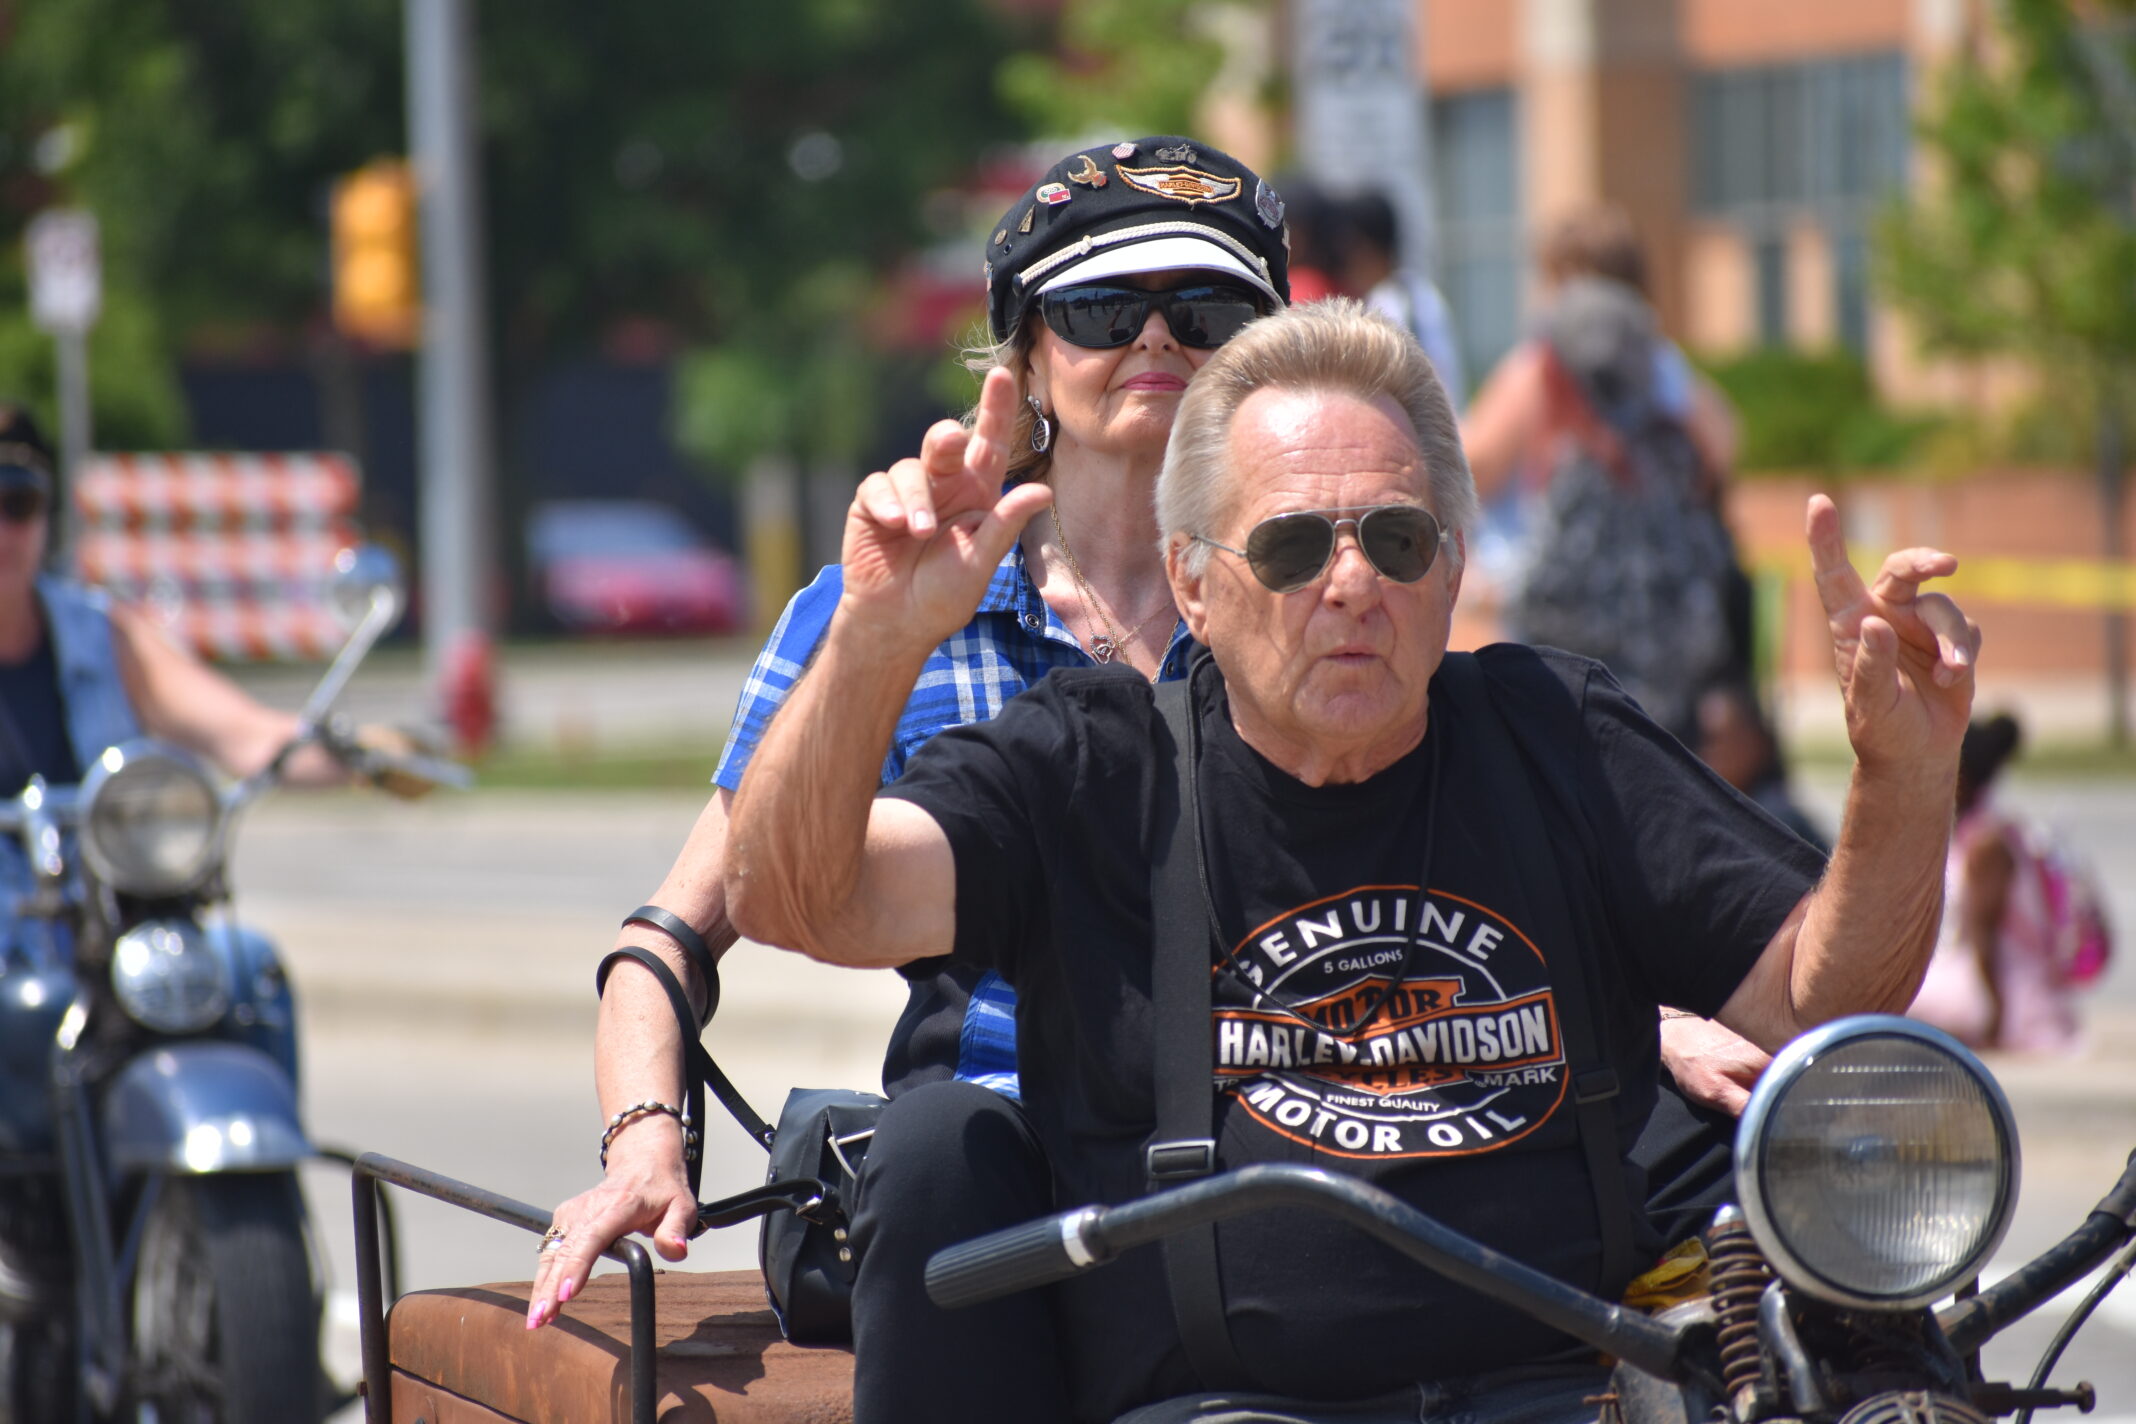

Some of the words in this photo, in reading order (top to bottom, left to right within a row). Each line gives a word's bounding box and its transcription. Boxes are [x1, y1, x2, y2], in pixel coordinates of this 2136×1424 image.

[1324, 960, 1333, 973] 5
[1338, 949, 1404, 973] GALLONS
[1219, 1004, 1550, 1067] HARLEY-DAVIDSON
[1484, 1067, 1557, 1088] MARK
[1326, 1093, 1374, 1108] FINEST
[1380, 1096, 1440, 1112] QUALITY
[1241, 1080, 1402, 1153] MOTOR
[1428, 1109, 1527, 1148] OIL
